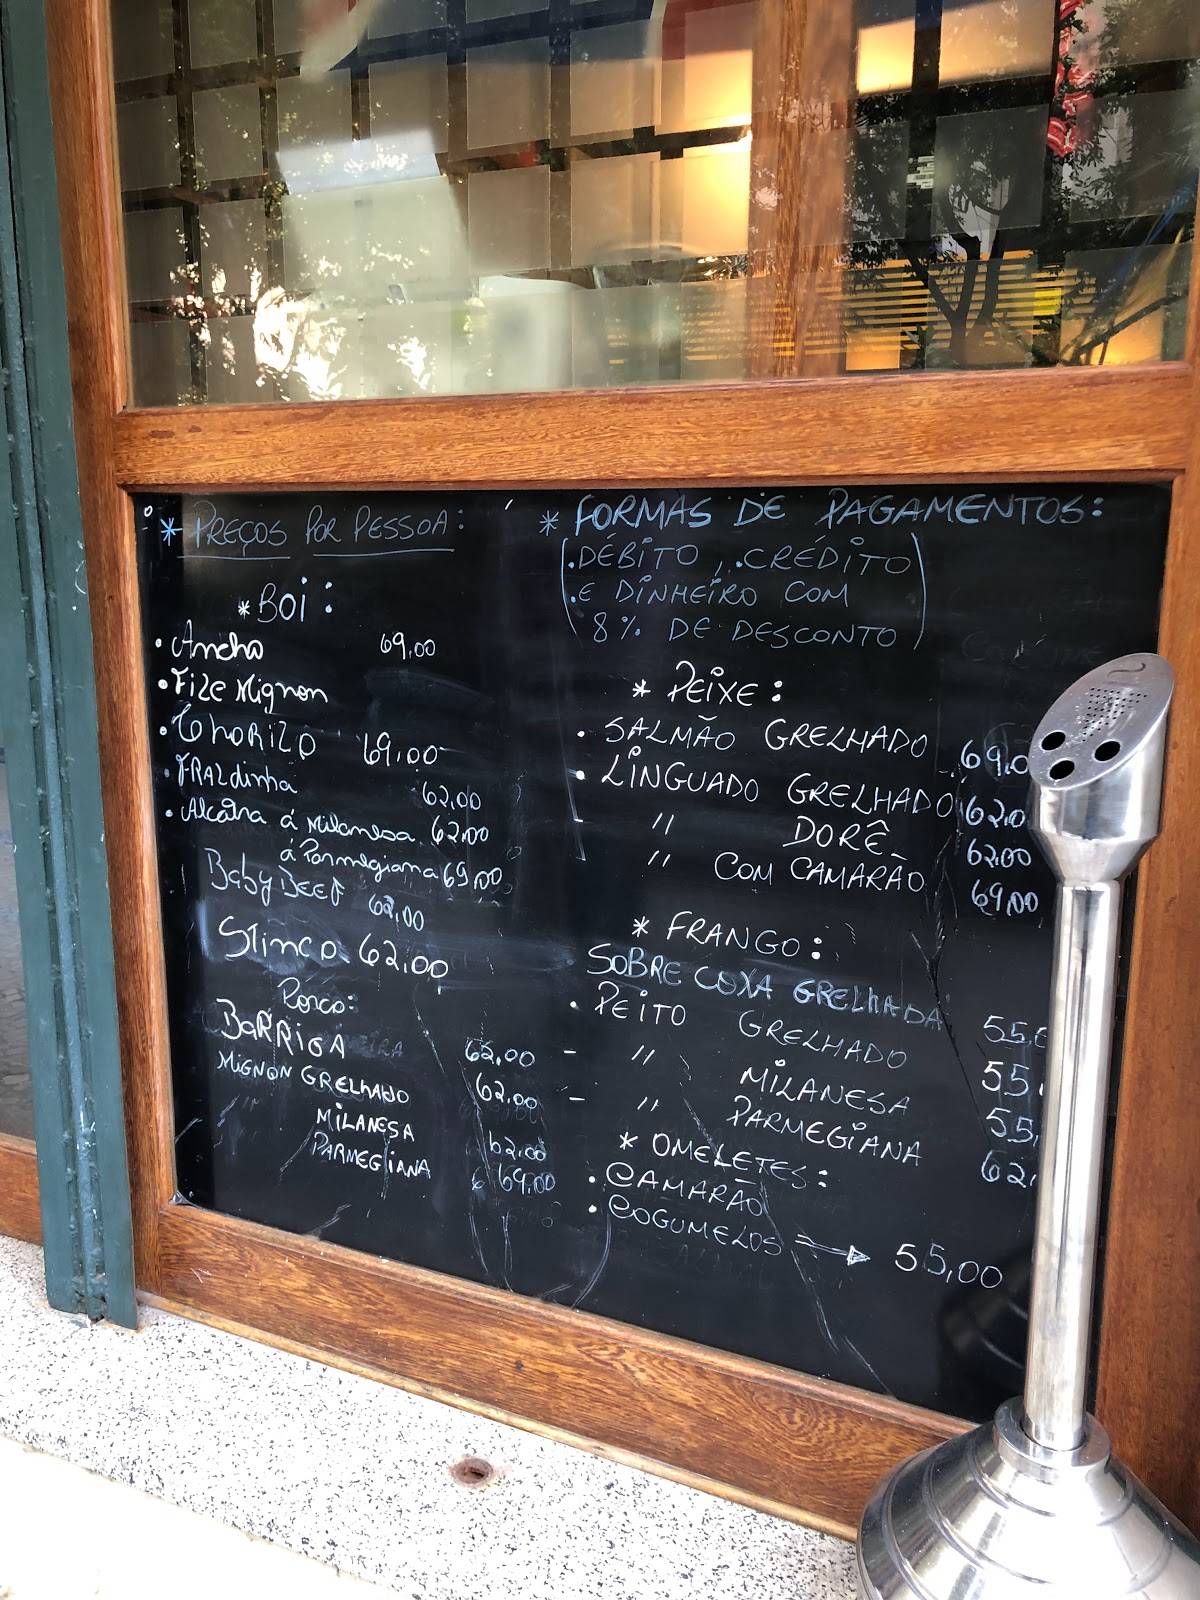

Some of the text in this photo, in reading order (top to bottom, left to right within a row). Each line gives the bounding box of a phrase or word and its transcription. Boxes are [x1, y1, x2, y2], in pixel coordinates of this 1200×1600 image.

[574, 496, 713, 535] FORMAS
[734, 497, 786, 527] DE
[668, 621, 706, 642] DE
[732, 621, 897, 648] DESCONTO
[605, 713, 1028, 777] SALMÃO GRELHADO 69,0
[787, 772, 954, 818] GRELHADO
[782, 815, 891, 856] DORÊ
[714, 851, 773, 886] COM
[790, 853, 925, 893] CAMARÃO
[739, 1009, 907, 1069] GRELHADO
[894, 1242, 1003, 1290] 55,00
